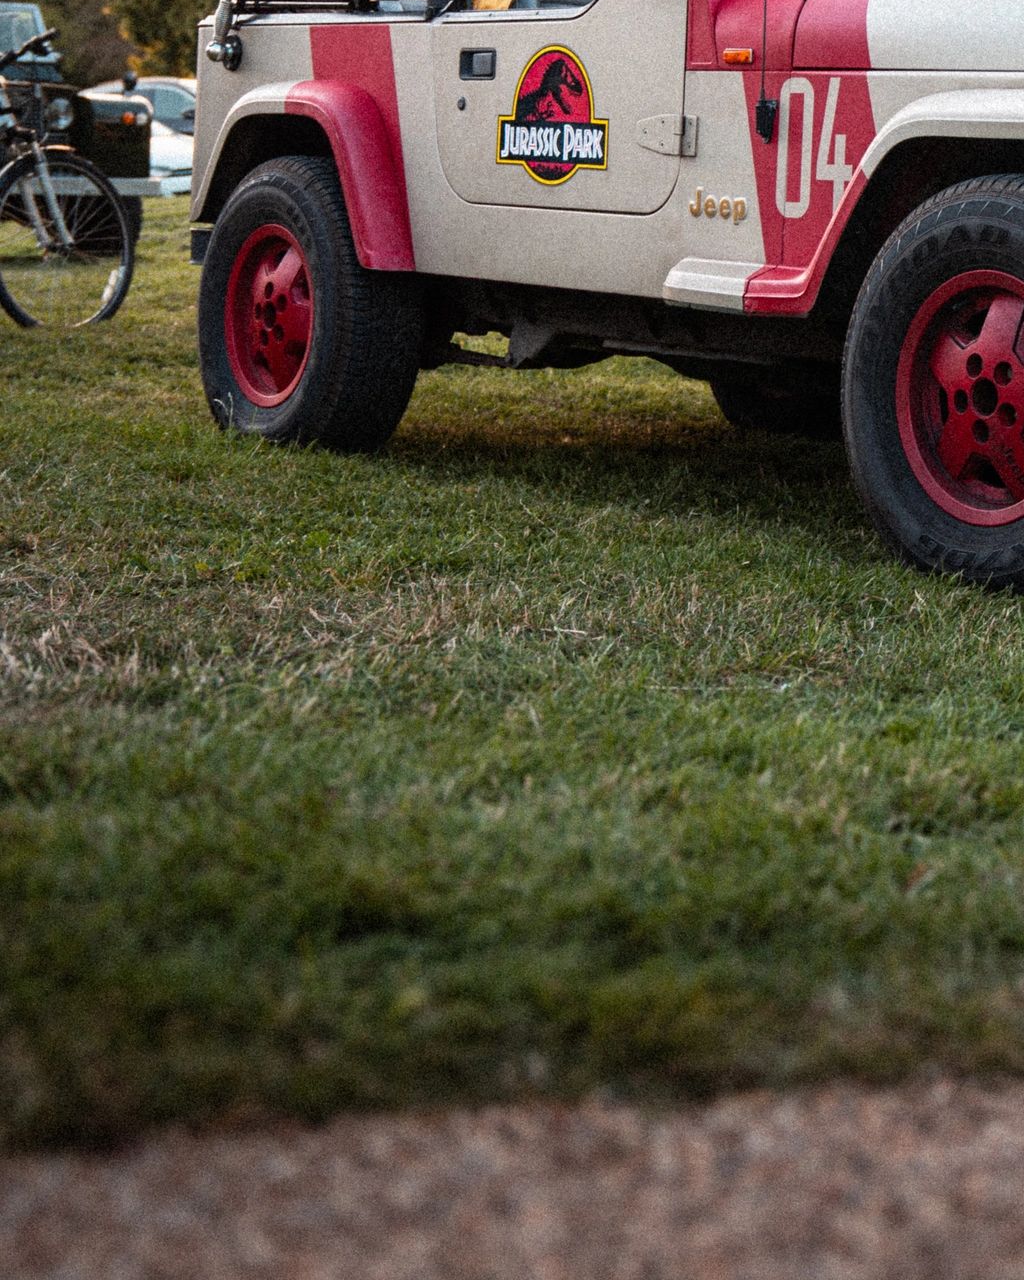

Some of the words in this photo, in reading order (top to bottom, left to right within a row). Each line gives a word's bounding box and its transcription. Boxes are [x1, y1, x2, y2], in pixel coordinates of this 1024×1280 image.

[501, 123, 562, 159] JURASSIC
[562, 124, 604, 161] PARK
[778, 76, 853, 219] 04
[689, 186, 747, 225] Jeep
